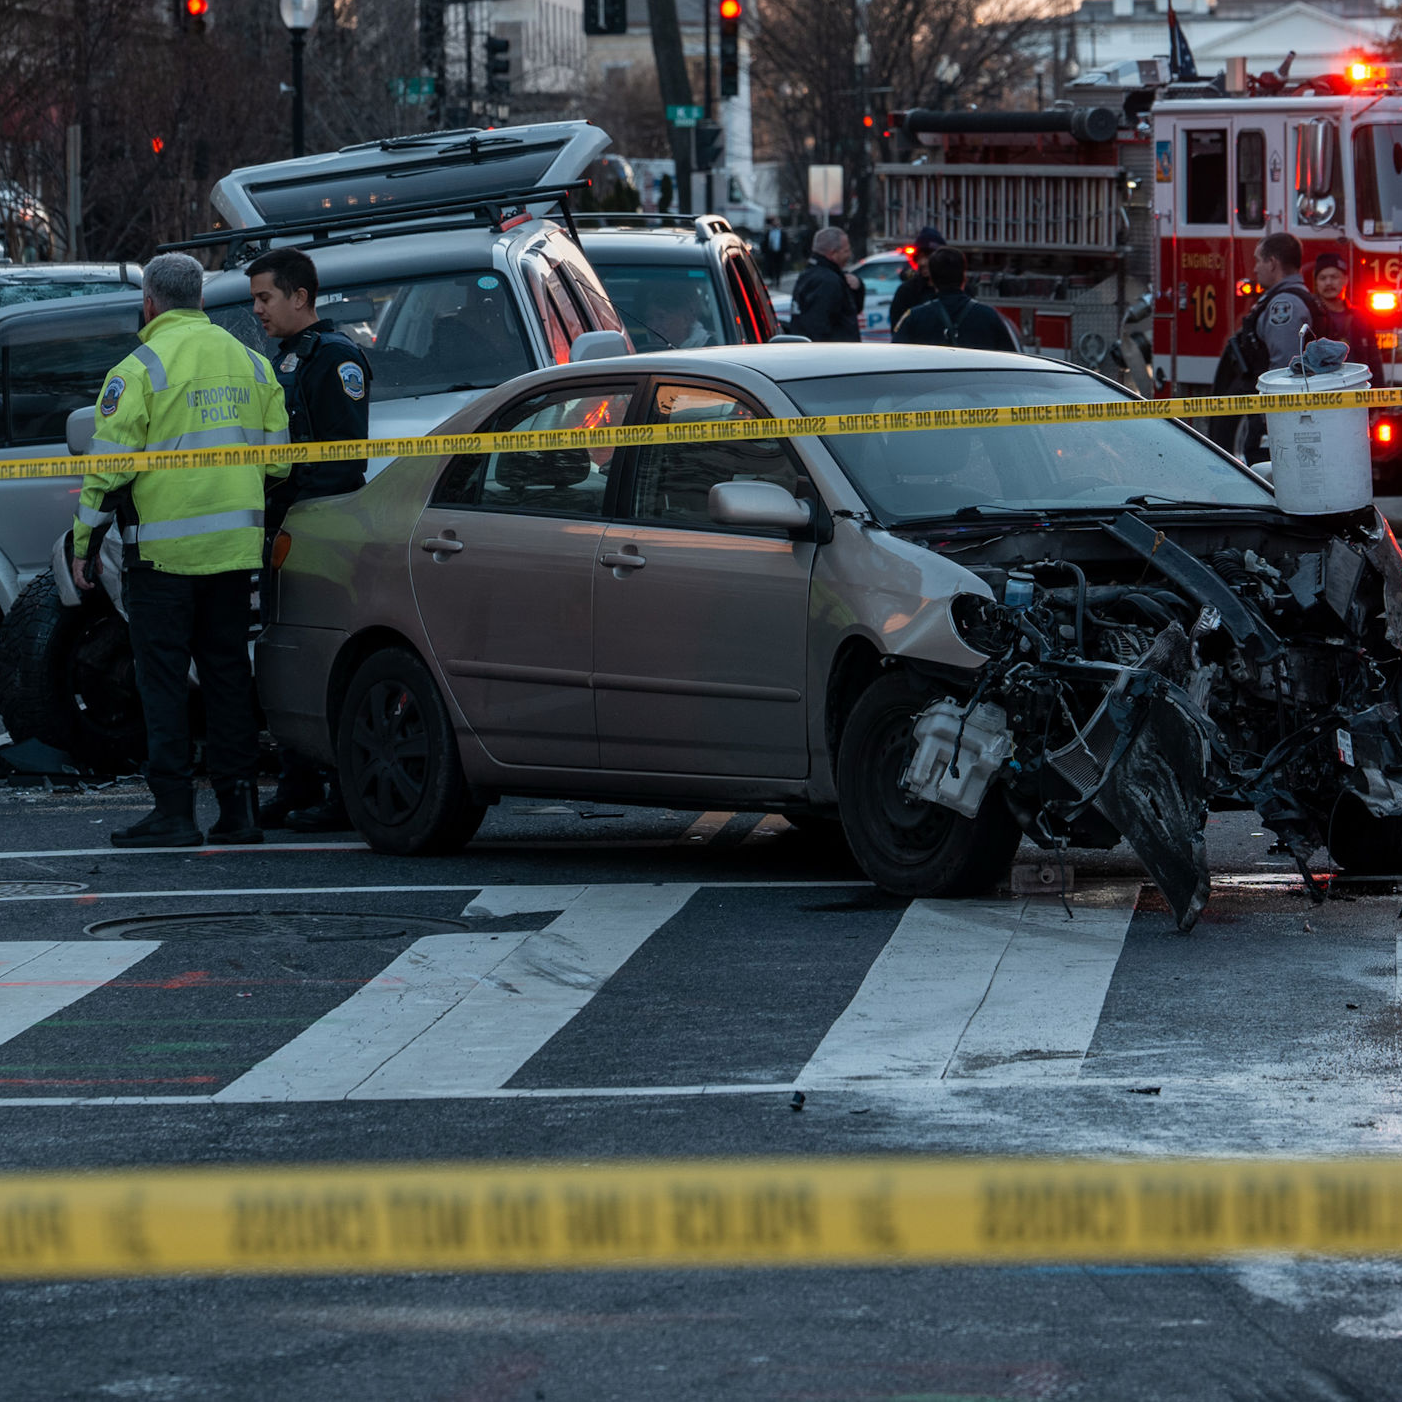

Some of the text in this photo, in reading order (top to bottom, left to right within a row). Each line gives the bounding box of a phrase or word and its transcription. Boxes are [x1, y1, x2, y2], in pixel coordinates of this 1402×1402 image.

[1181, 252, 1213, 269] ENGINE
[1191, 283, 1217, 331] 16
[201, 404, 239, 424] POLIC
